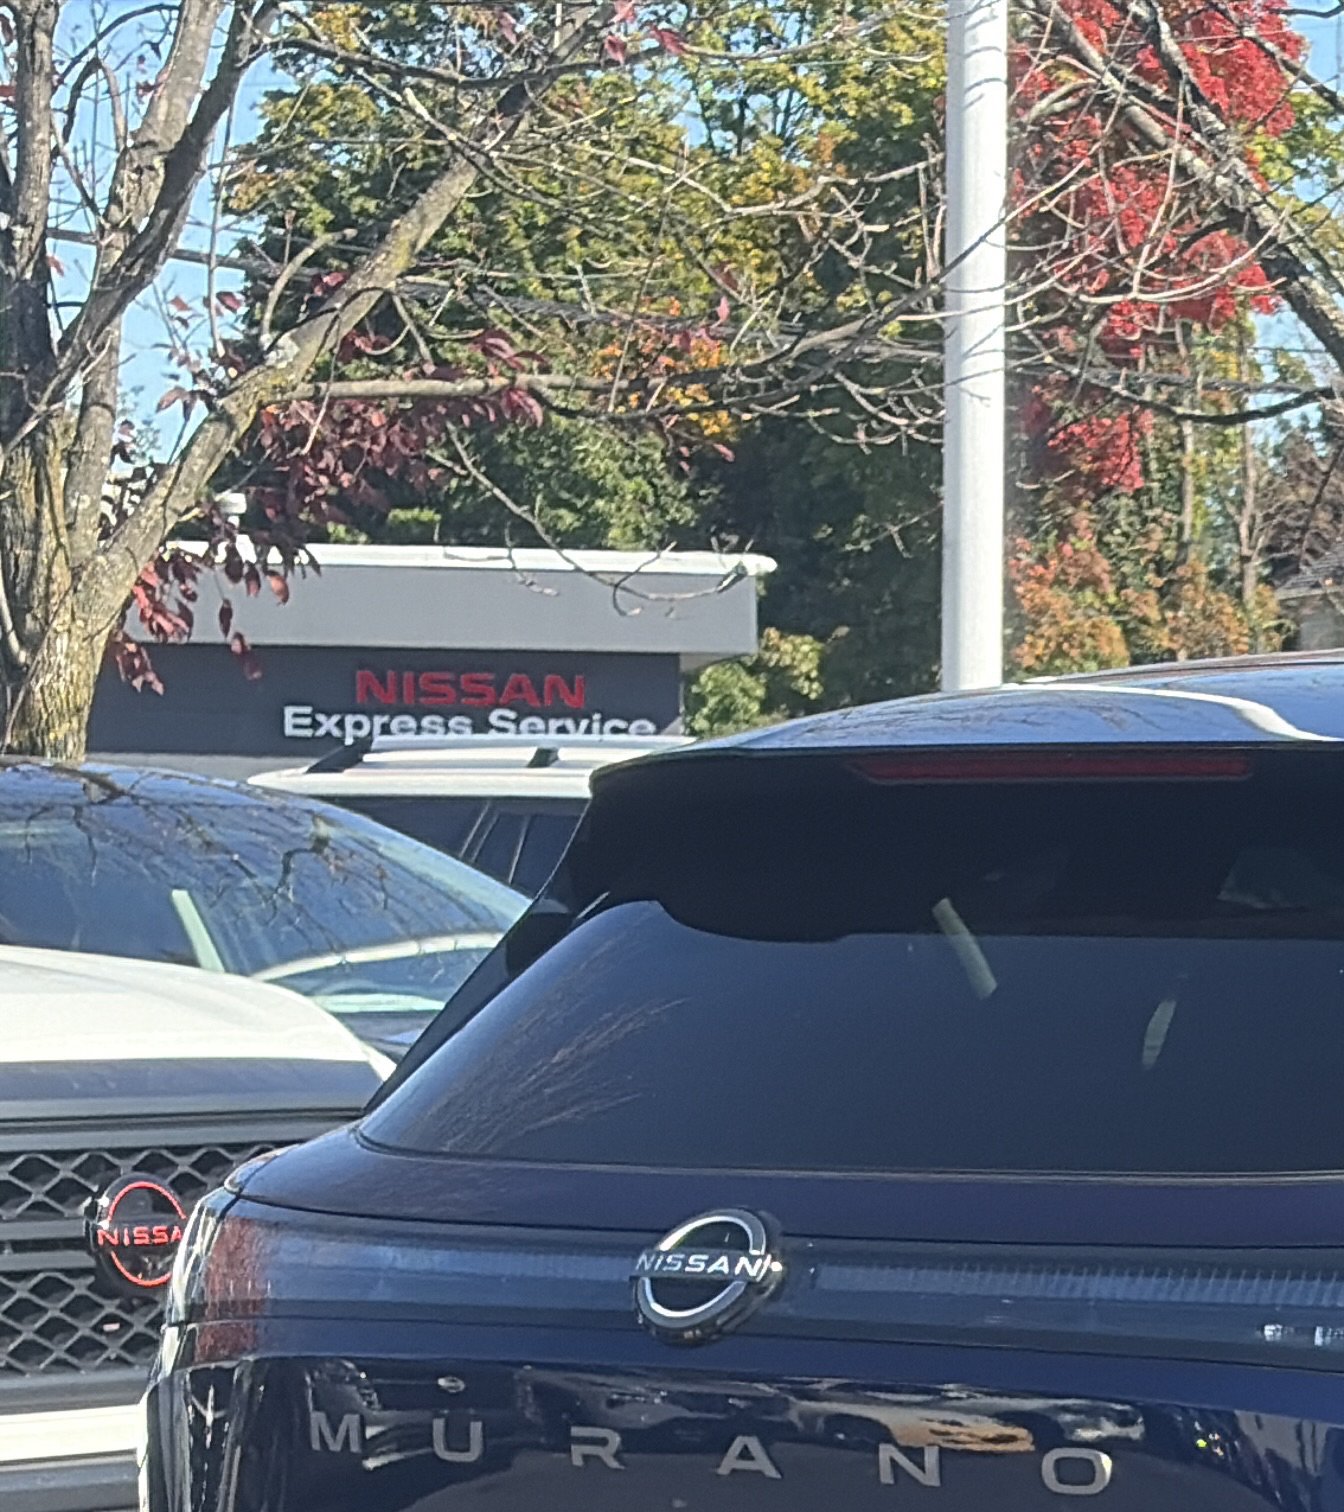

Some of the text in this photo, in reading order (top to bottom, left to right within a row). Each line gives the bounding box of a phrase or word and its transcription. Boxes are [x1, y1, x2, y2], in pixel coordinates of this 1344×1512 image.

[355, 669, 586, 709] NISSAN
[283, 705, 657, 745] Express Service
[97, 1225, 183, 1246] NISSA
[635, 1253, 767, 1282] NISSAN
[308, 1410, 1114, 1497] MURANO
